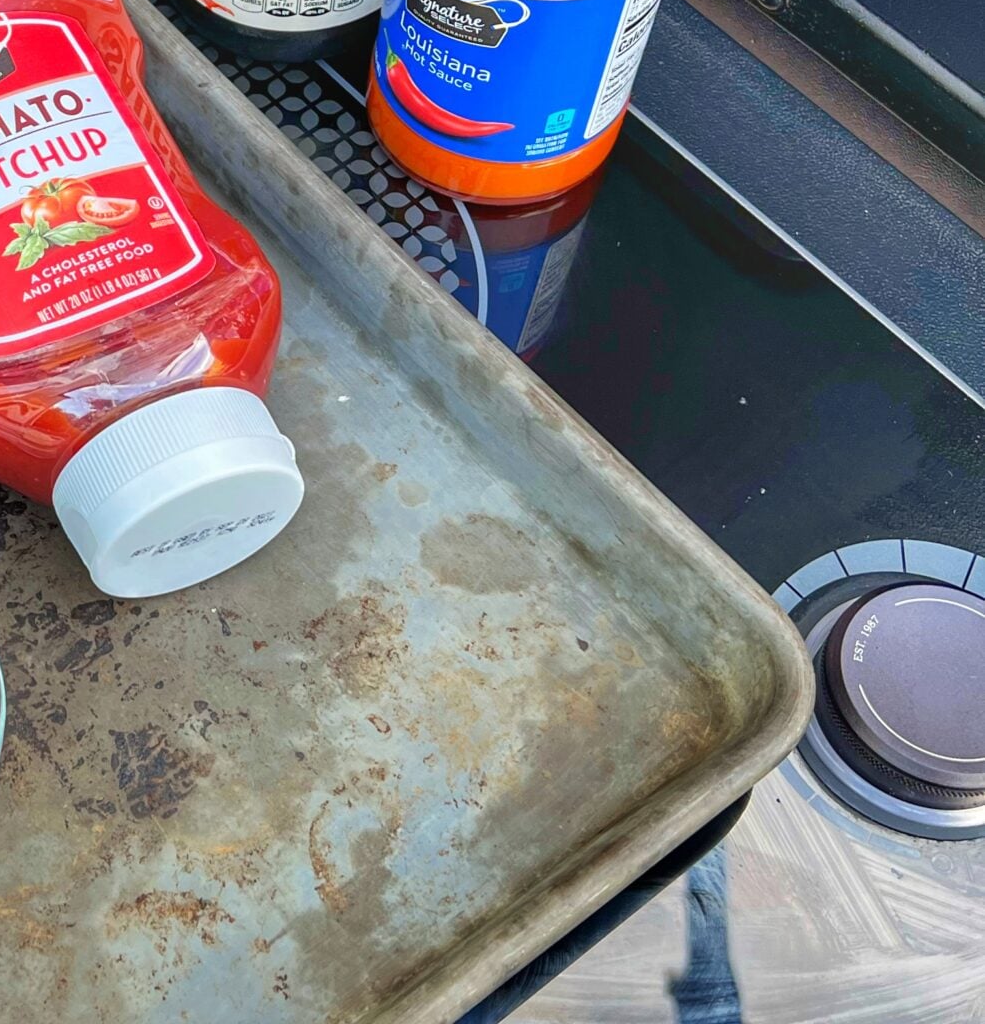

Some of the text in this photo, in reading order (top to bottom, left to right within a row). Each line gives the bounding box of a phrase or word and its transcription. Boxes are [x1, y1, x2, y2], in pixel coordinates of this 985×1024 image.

[400, 10, 491, 82] Louisiana
[430, 10, 482, 34] SELECT
[436, 25, 483, 43] GUARANTEED
[404, 40, 426, 67] Hot
[428, 61, 473, 91] Sauce
[23, 243, 154, 302] AND FAT FREE FOOD
[31, 237, 135, 284] A CHOLESTEROL
[37, 309, 55, 323] NET
[53, 300, 70, 315] WT
[68, 294, 81, 309] 20
[80, 288, 94, 304] OZ
[103, 280, 115, 295] LB
[115, 277, 122, 290] 4
[122, 272, 138, 287] OZ)
[135, 267, 153, 283] 567
[853, 614, 880, 662] EST. 1987
